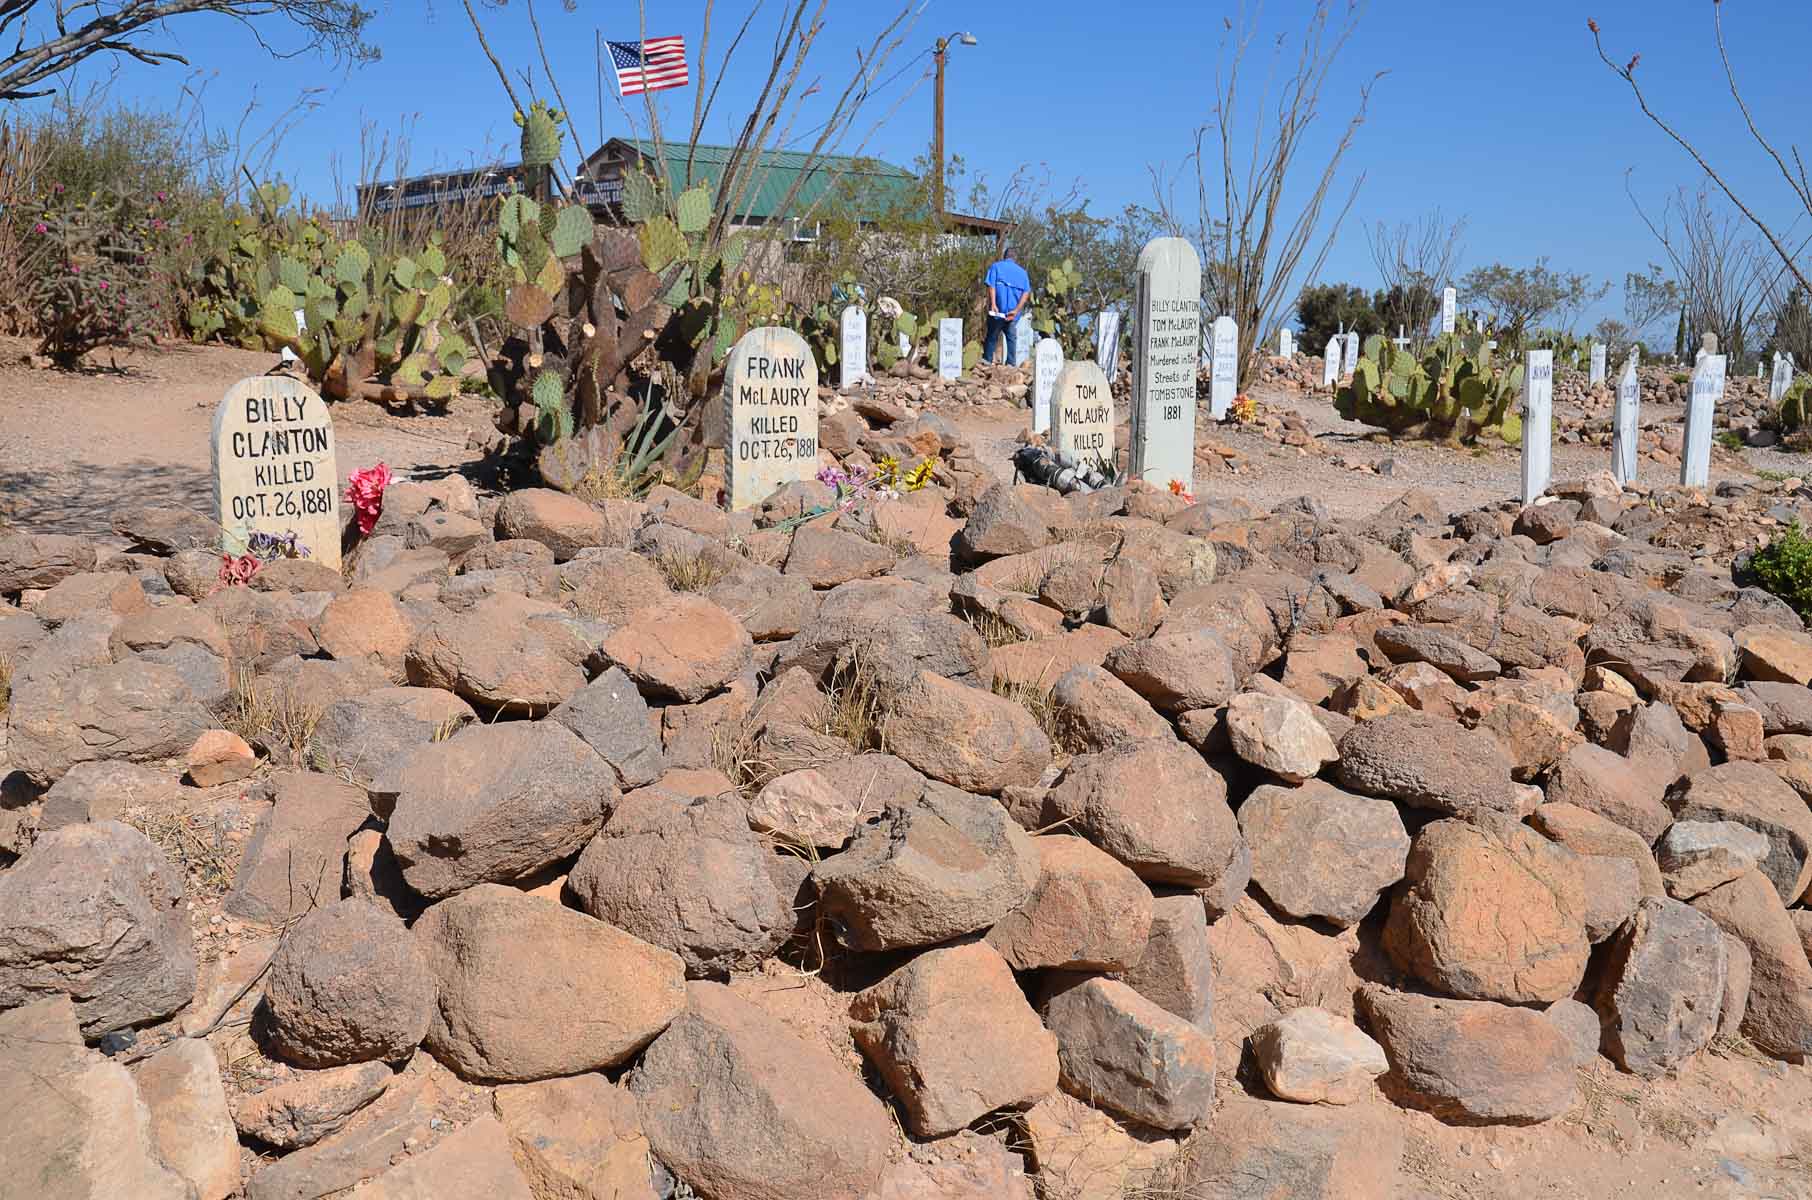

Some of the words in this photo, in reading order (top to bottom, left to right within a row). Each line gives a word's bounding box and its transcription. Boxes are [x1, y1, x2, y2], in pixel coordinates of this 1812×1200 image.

[1151, 300, 1170, 312] BILLY
[1172, 300, 1200, 312] CLANTON
[1152, 319, 1166, 331] TOM
[1150, 336, 1169, 348] FRANK
[747, 357, 805, 379] FRANK
[1150, 354, 1180, 366] Murdered
[1155, 371, 1180, 384] Streets
[1182, 370, 1190, 382] of
[740, 386, 810, 406] McLAURY
[1076, 384, 1097, 400] TOM
[1150, 386, 1194, 400] TOMBSTONE
[246, 396, 307, 423] BILLY
[1064, 407, 1110, 424] McLAURY
[1164, 405, 1181, 420] 1881
[751, 416, 798, 435] KILLED
[232, 427, 328, 458] CLANTON
[1074, 432, 1104, 450] KILLED
[740, 440, 771, 460] OCT.
[255, 460, 314, 486] KILLED
[232, 493, 270, 520] OCT.
